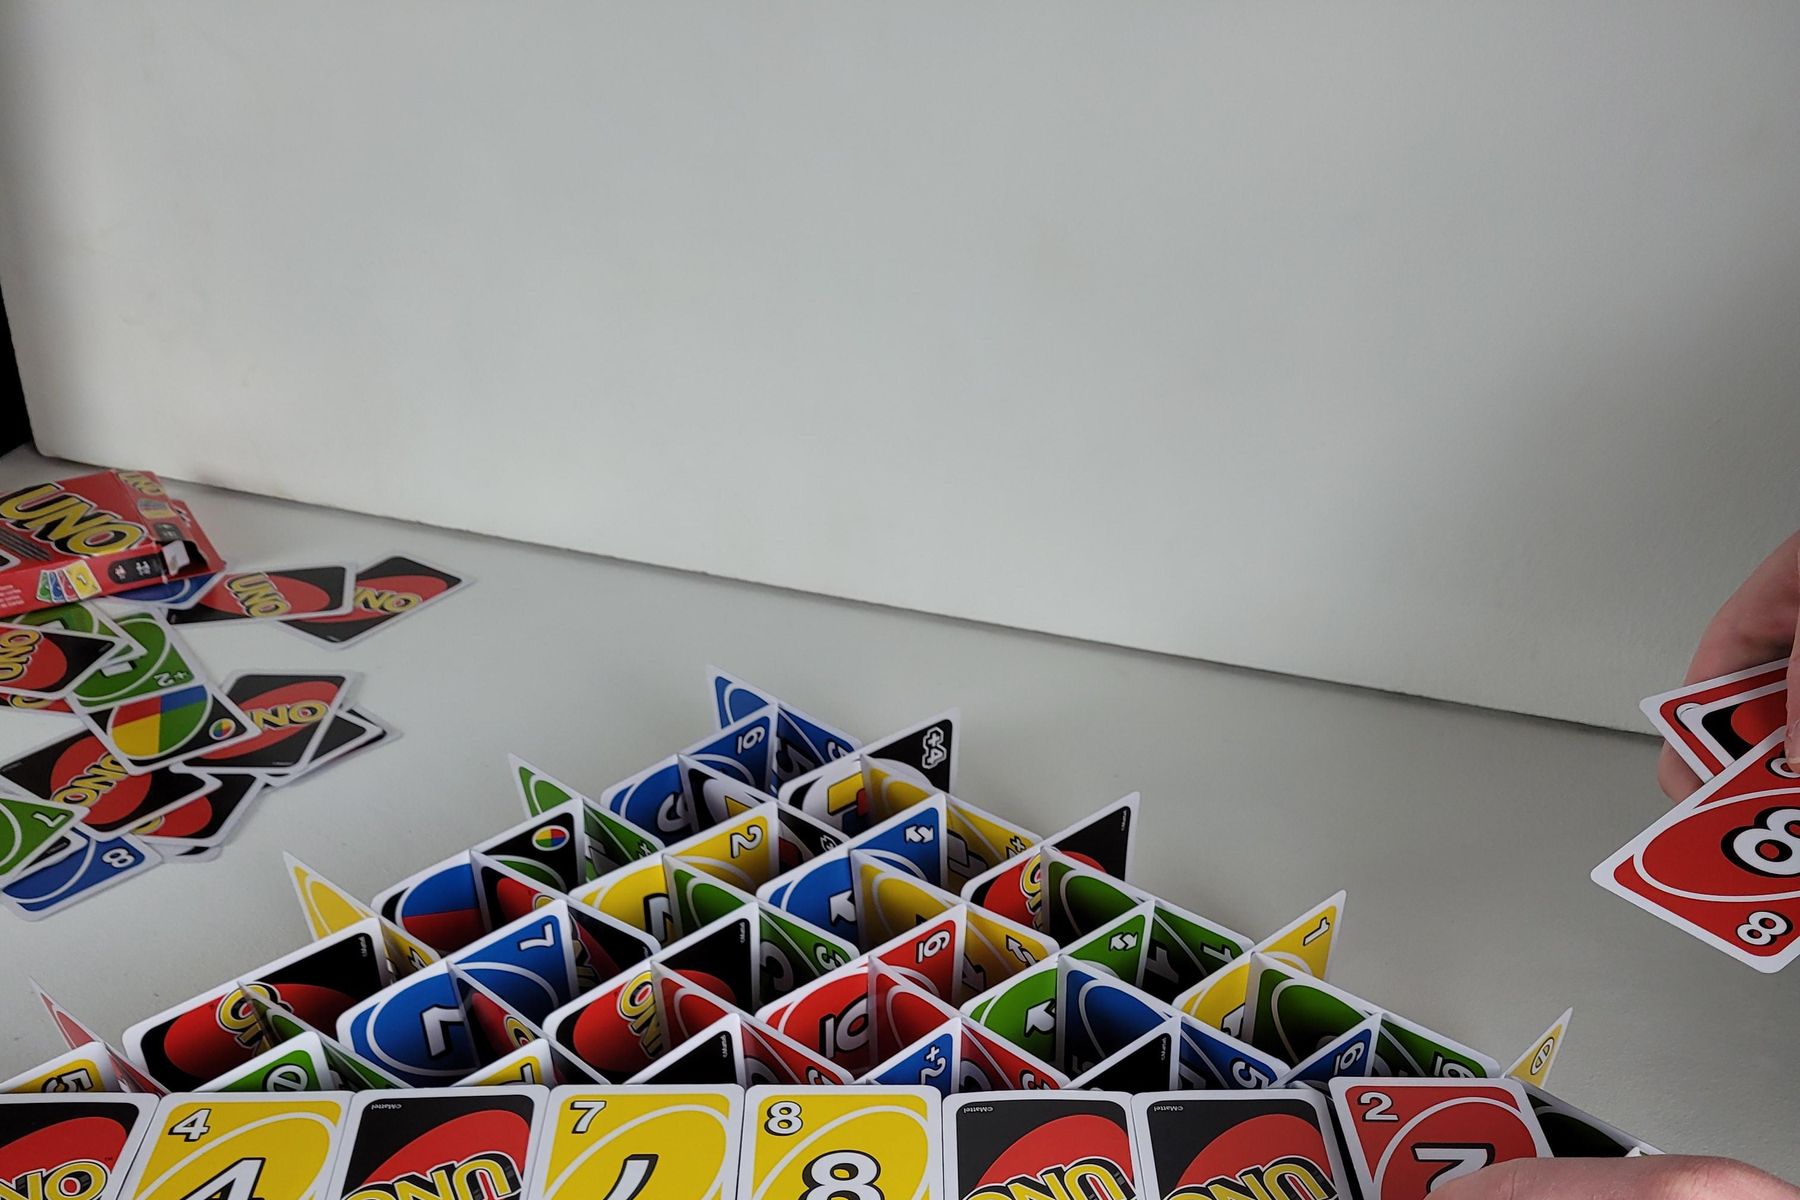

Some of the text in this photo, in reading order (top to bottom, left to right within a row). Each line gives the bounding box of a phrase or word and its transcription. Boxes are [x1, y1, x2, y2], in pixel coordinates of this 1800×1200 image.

[0, 483, 147, 557] UNO
[226, 573, 291, 618] UNO
[355, 587, 422, 614] NO
[249, 700, 331, 732] NO
[102, 847, 136, 869] 8
[731, 824, 764, 859] 2
[518, 922, 556, 952] 7
[1736, 910, 1794, 947] 8
[570, 1100, 607, 1134] 7
[764, 1101, 804, 1137] 8
[1356, 1091, 1399, 1122] 2
[168, 1108, 212, 1143] 4
